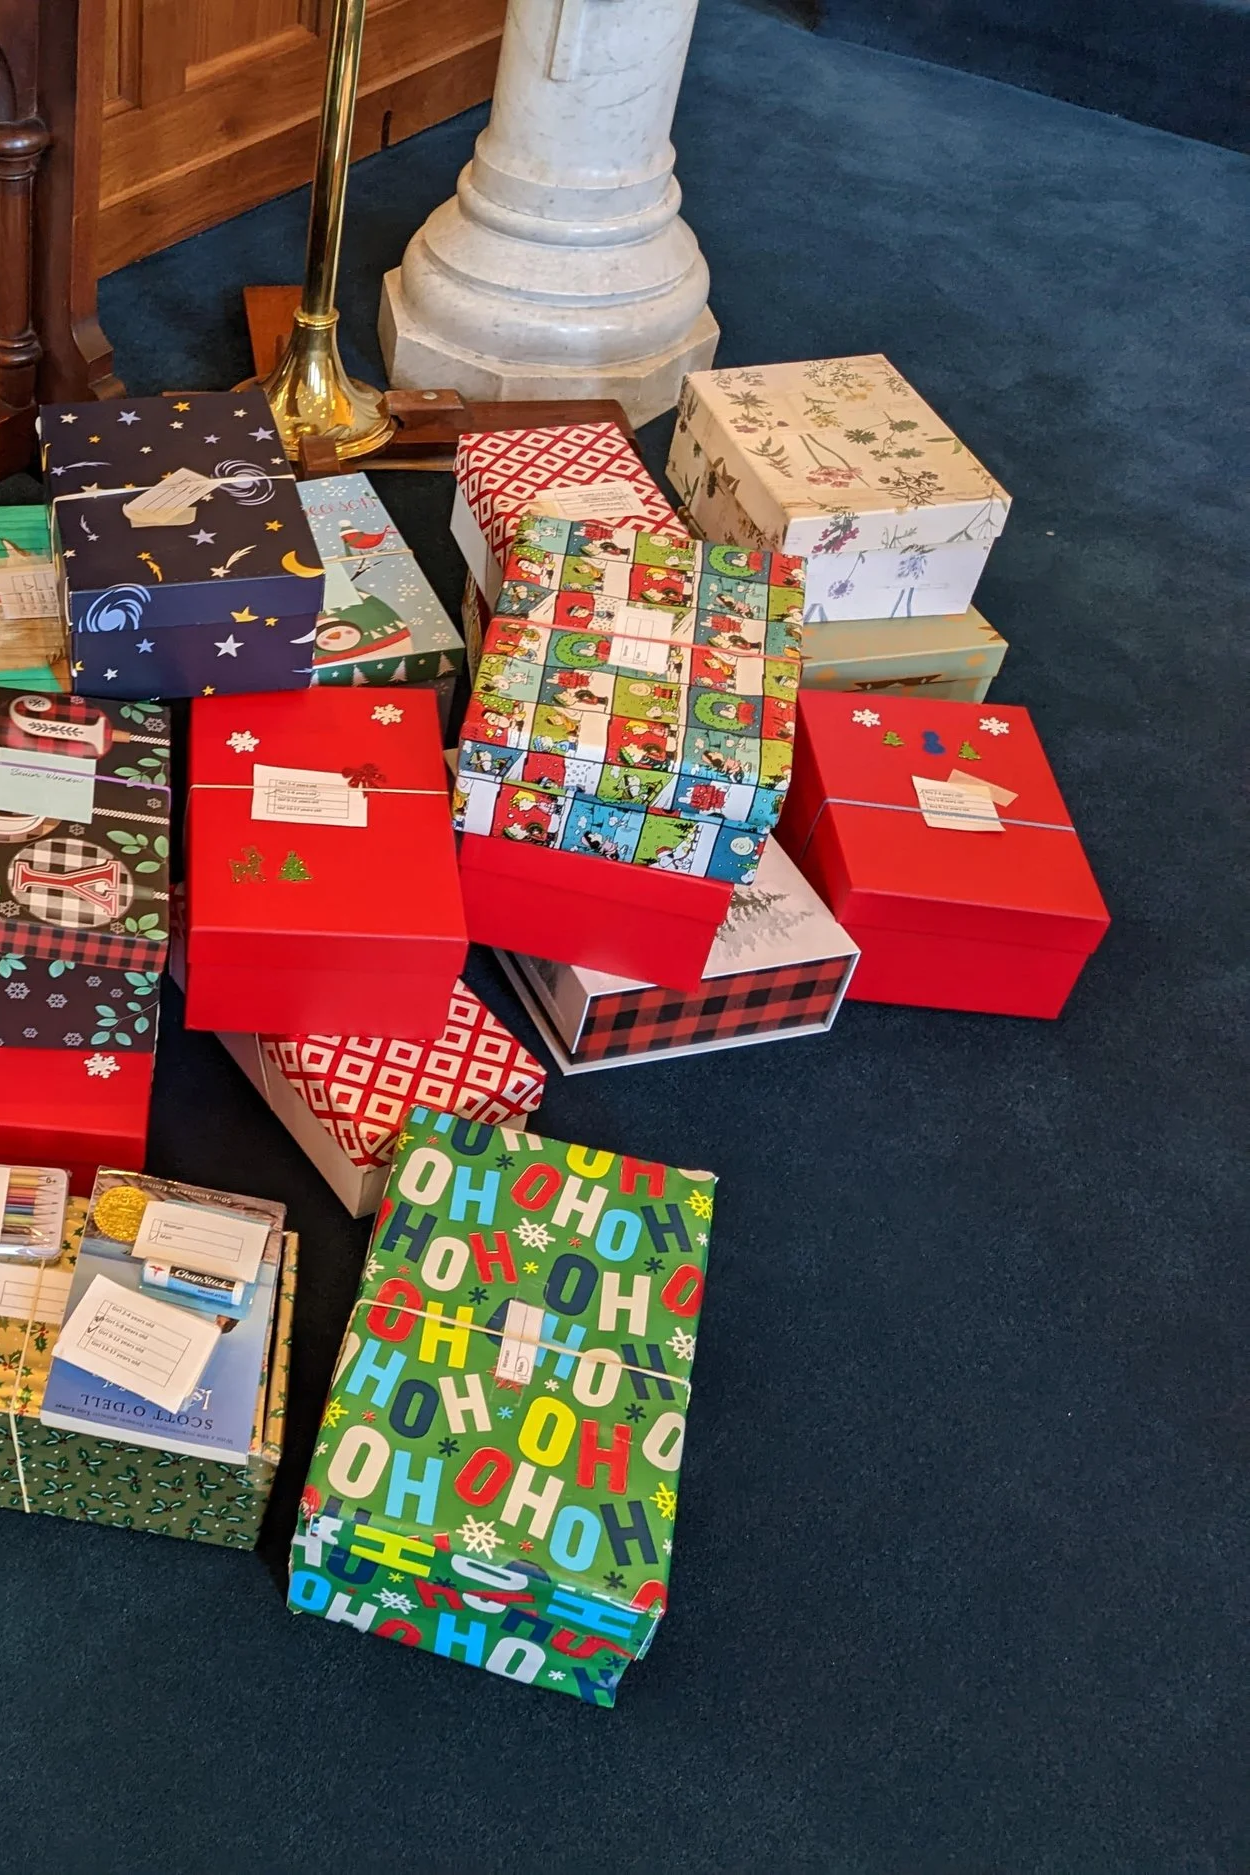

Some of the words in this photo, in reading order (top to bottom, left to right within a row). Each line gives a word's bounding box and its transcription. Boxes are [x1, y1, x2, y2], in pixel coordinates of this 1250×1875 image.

[175, 1269, 227, 1288] ChapStick
[105, 1317, 116, 1325] Girl
[124, 1327, 139, 1337] years
[138, 1332, 149, 1340] old
[111, 1305, 122, 1314] Girl
[130, 1315, 145, 1325] years
[145, 1320, 155, 1329] old
[98, 1328, 109, 1337] Girl
[120, 1339, 135, 1350] years
[134, 1345, 145, 1354] old
[91, 1340, 102, 1348] Girl
[115, 1353, 131, 1363] years
[130, 1359, 141, 1367] old
[80, 1393, 146, 1418] O'DELL
[153, 1408, 214, 1432] SCOTT
